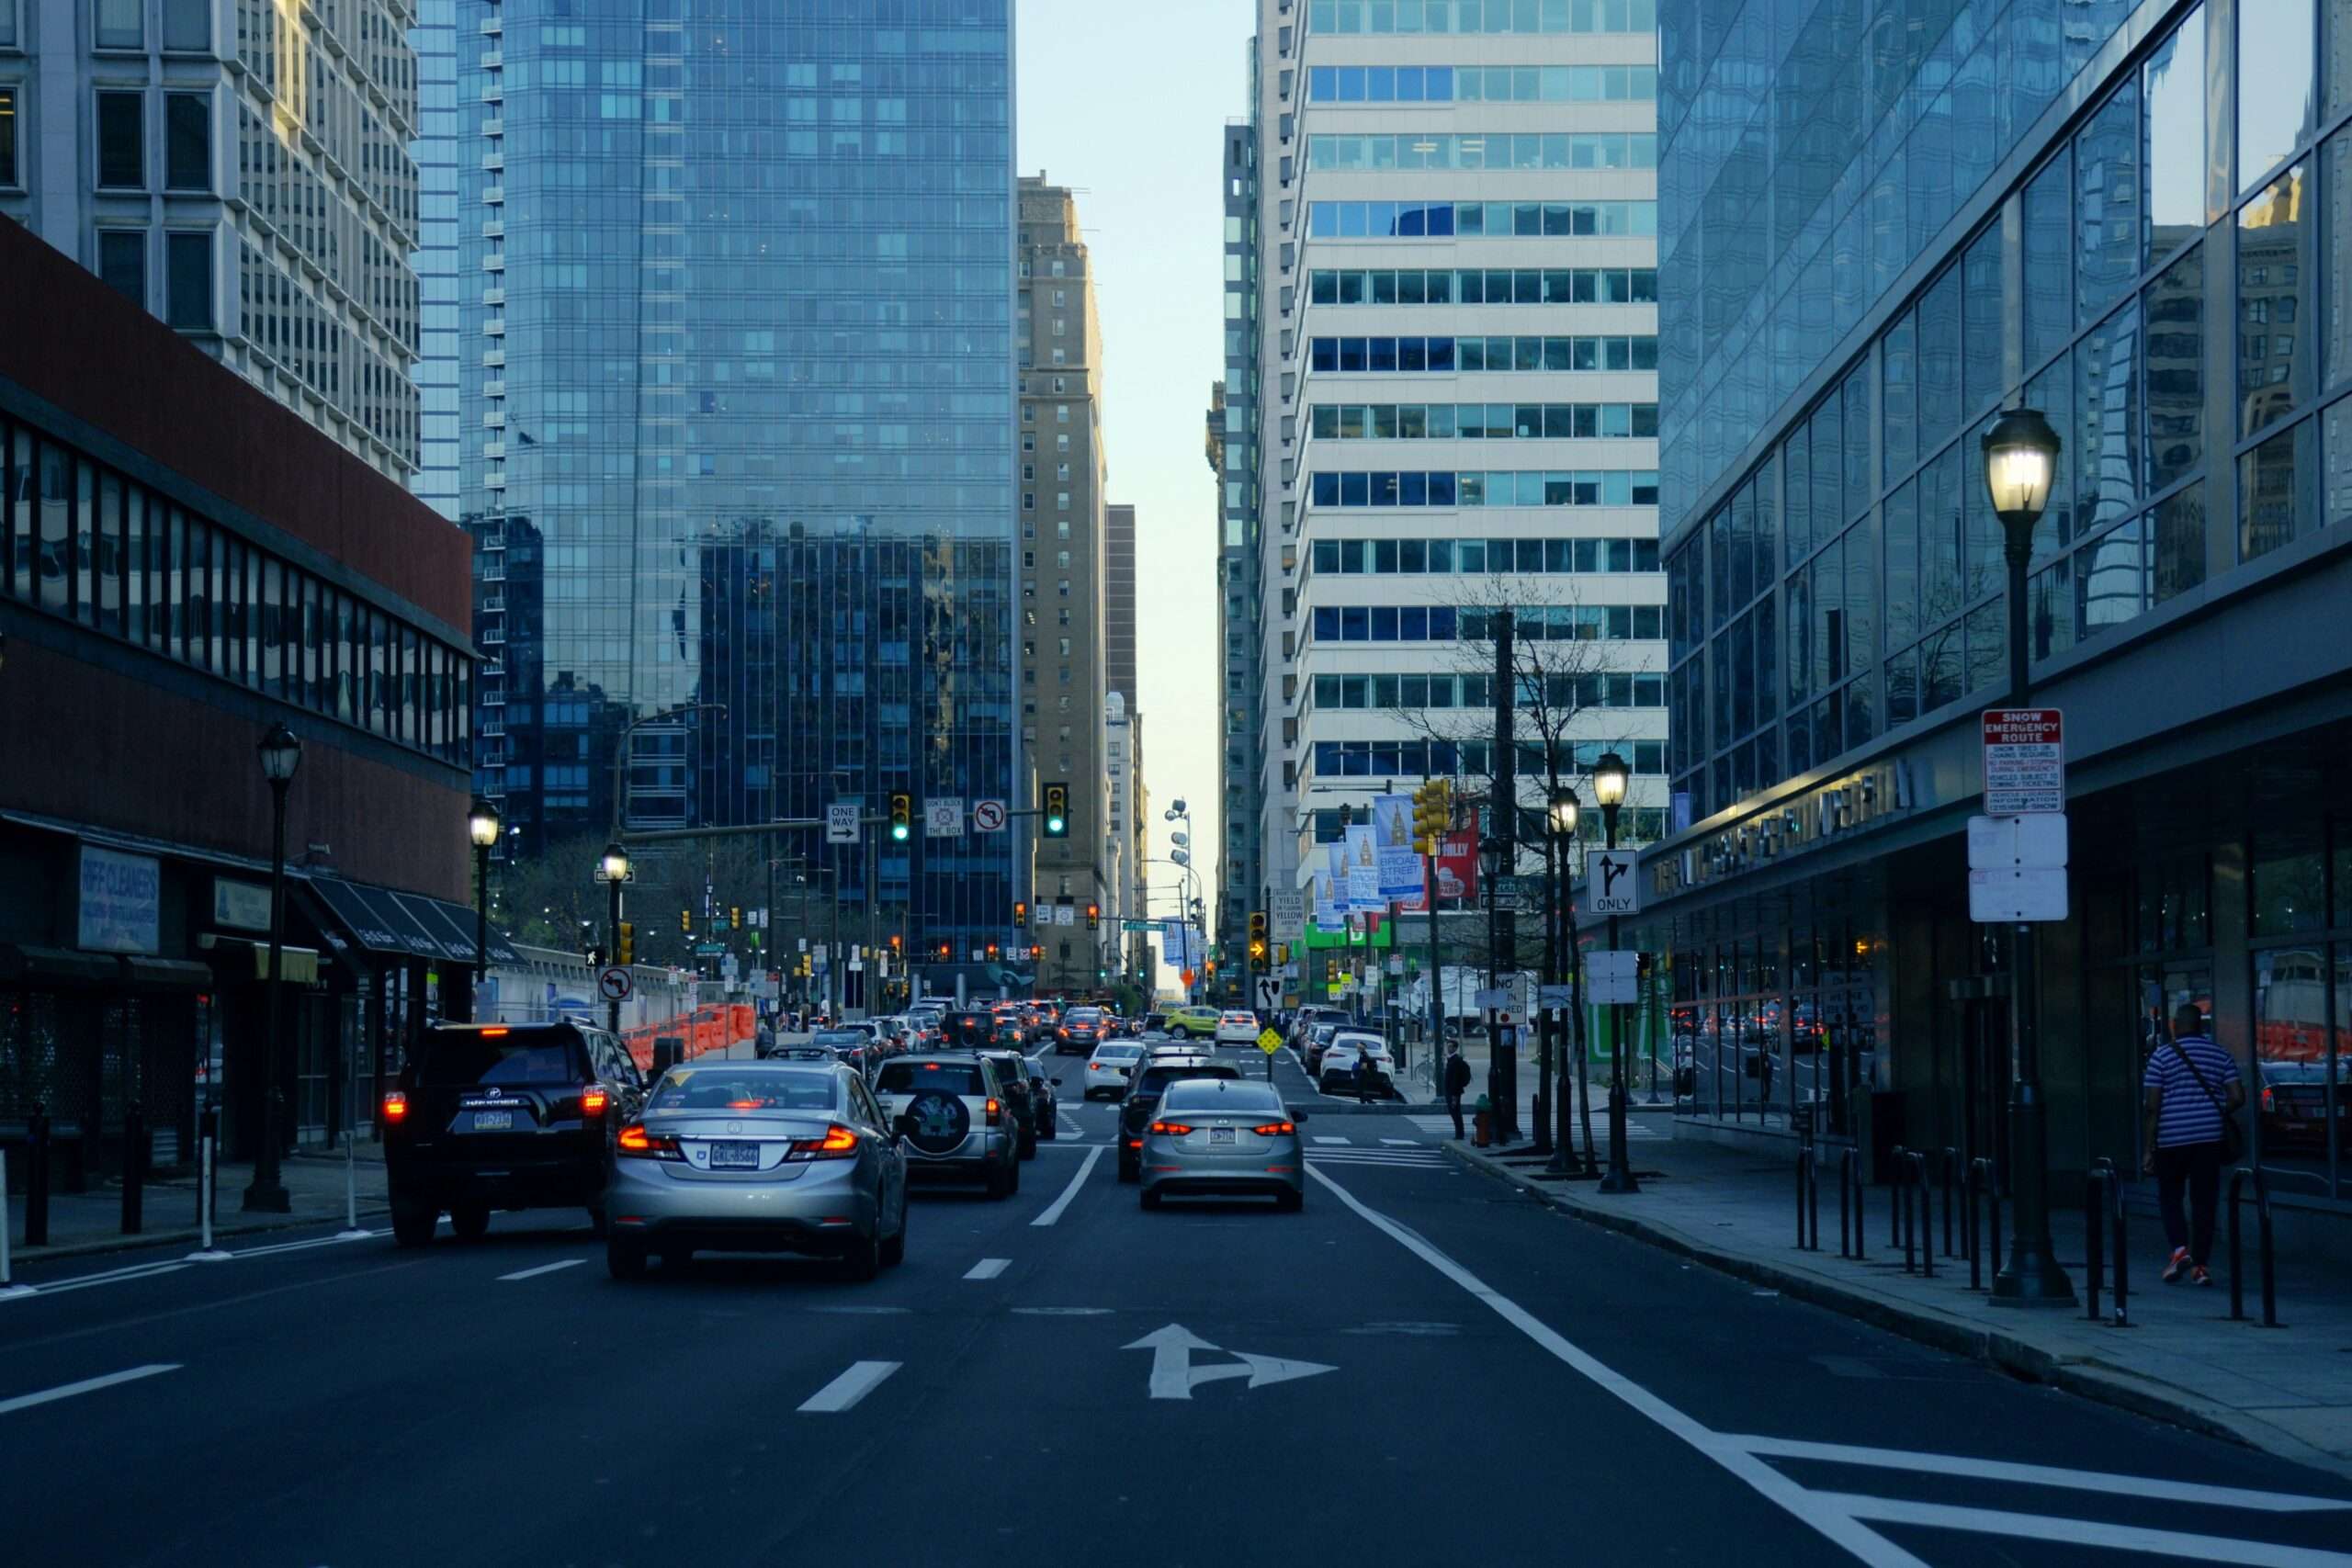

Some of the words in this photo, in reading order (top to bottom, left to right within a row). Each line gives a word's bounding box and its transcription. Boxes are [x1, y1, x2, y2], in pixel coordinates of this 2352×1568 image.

[2002, 713, 2041, 721] SNOW
[1985, 723, 2058, 732] EMERGENCY
[2001, 733, 2043, 742] ROUTE
[831, 807, 854, 817] ONE
[831, 818, 854, 827] WAY
[1442, 843, 1469, 856] HILLY
[1381, 855, 1419, 866] BROAD
[1381, 865, 1419, 875] STREET
[1382, 876, 1404, 886] RUN
[1598, 898, 1631, 910] ONLY
[1497, 978, 1512, 988] NO
[1505, 1005, 1521, 1013] RED
